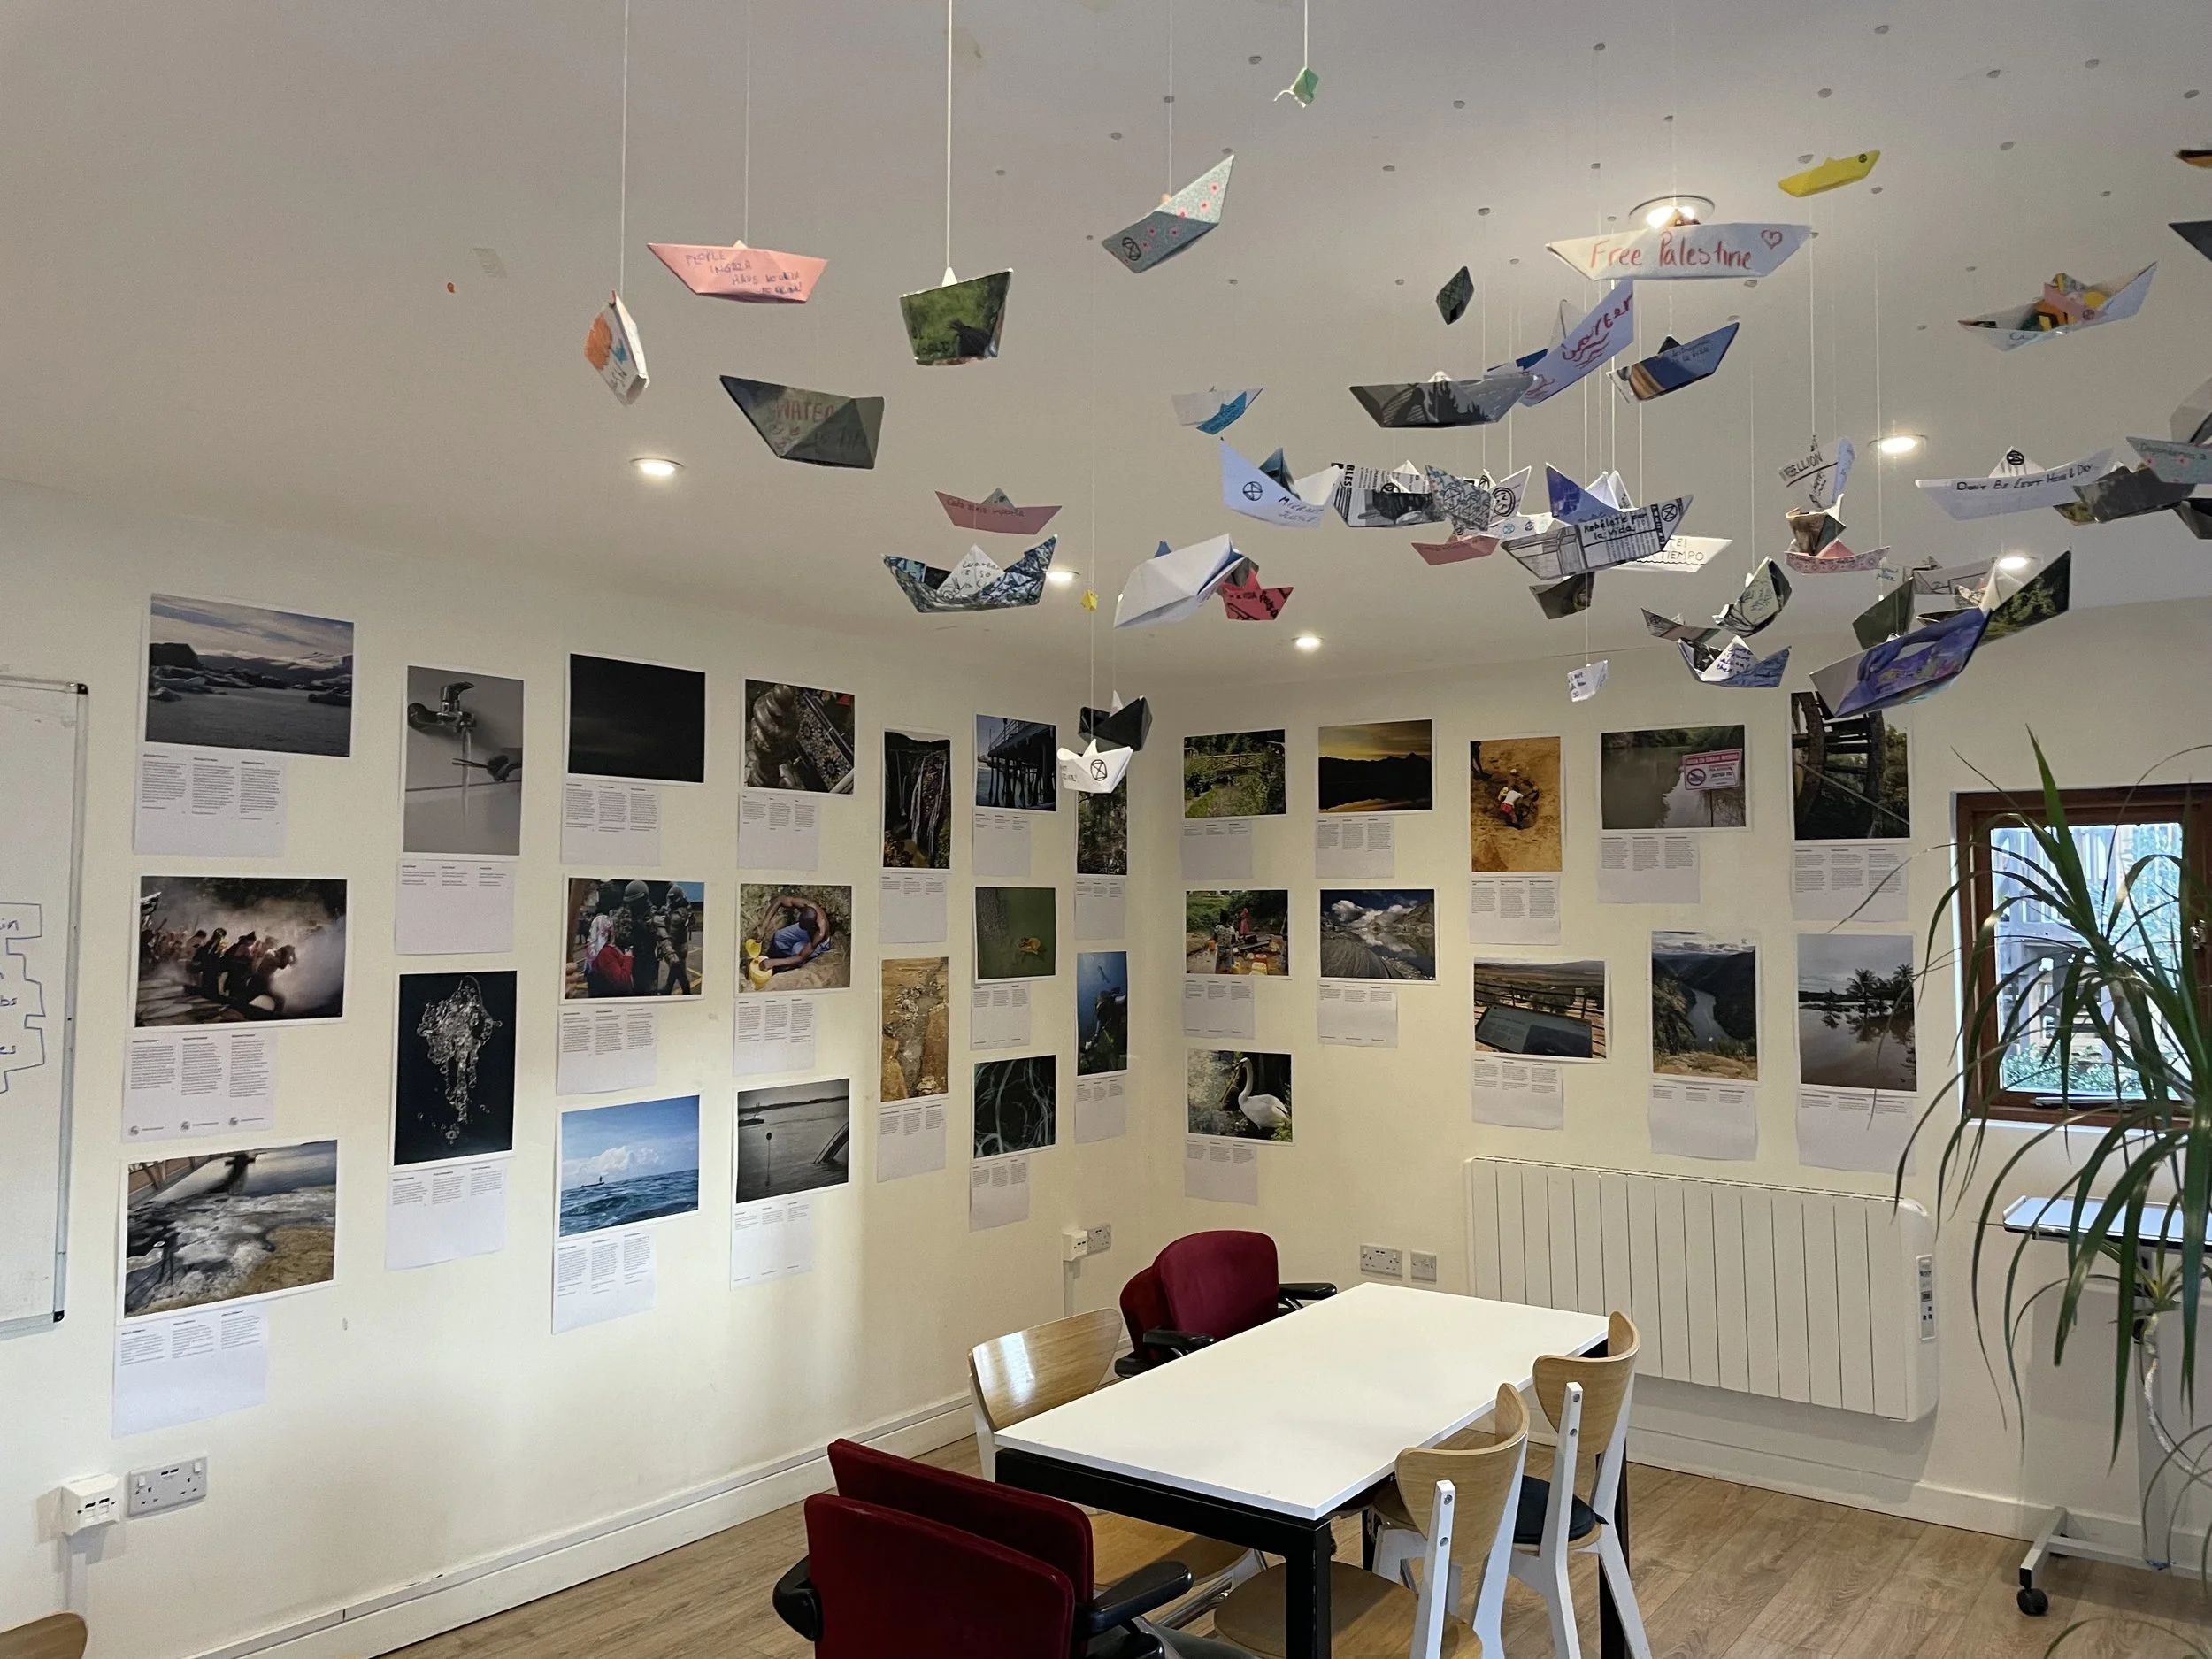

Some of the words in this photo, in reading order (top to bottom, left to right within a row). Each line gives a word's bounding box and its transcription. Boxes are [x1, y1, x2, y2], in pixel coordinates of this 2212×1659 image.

[686, 250, 726, 265] PEOPLE
[1590, 240, 1643, 268] Free
[1659, 230, 1752, 269] Palestine
